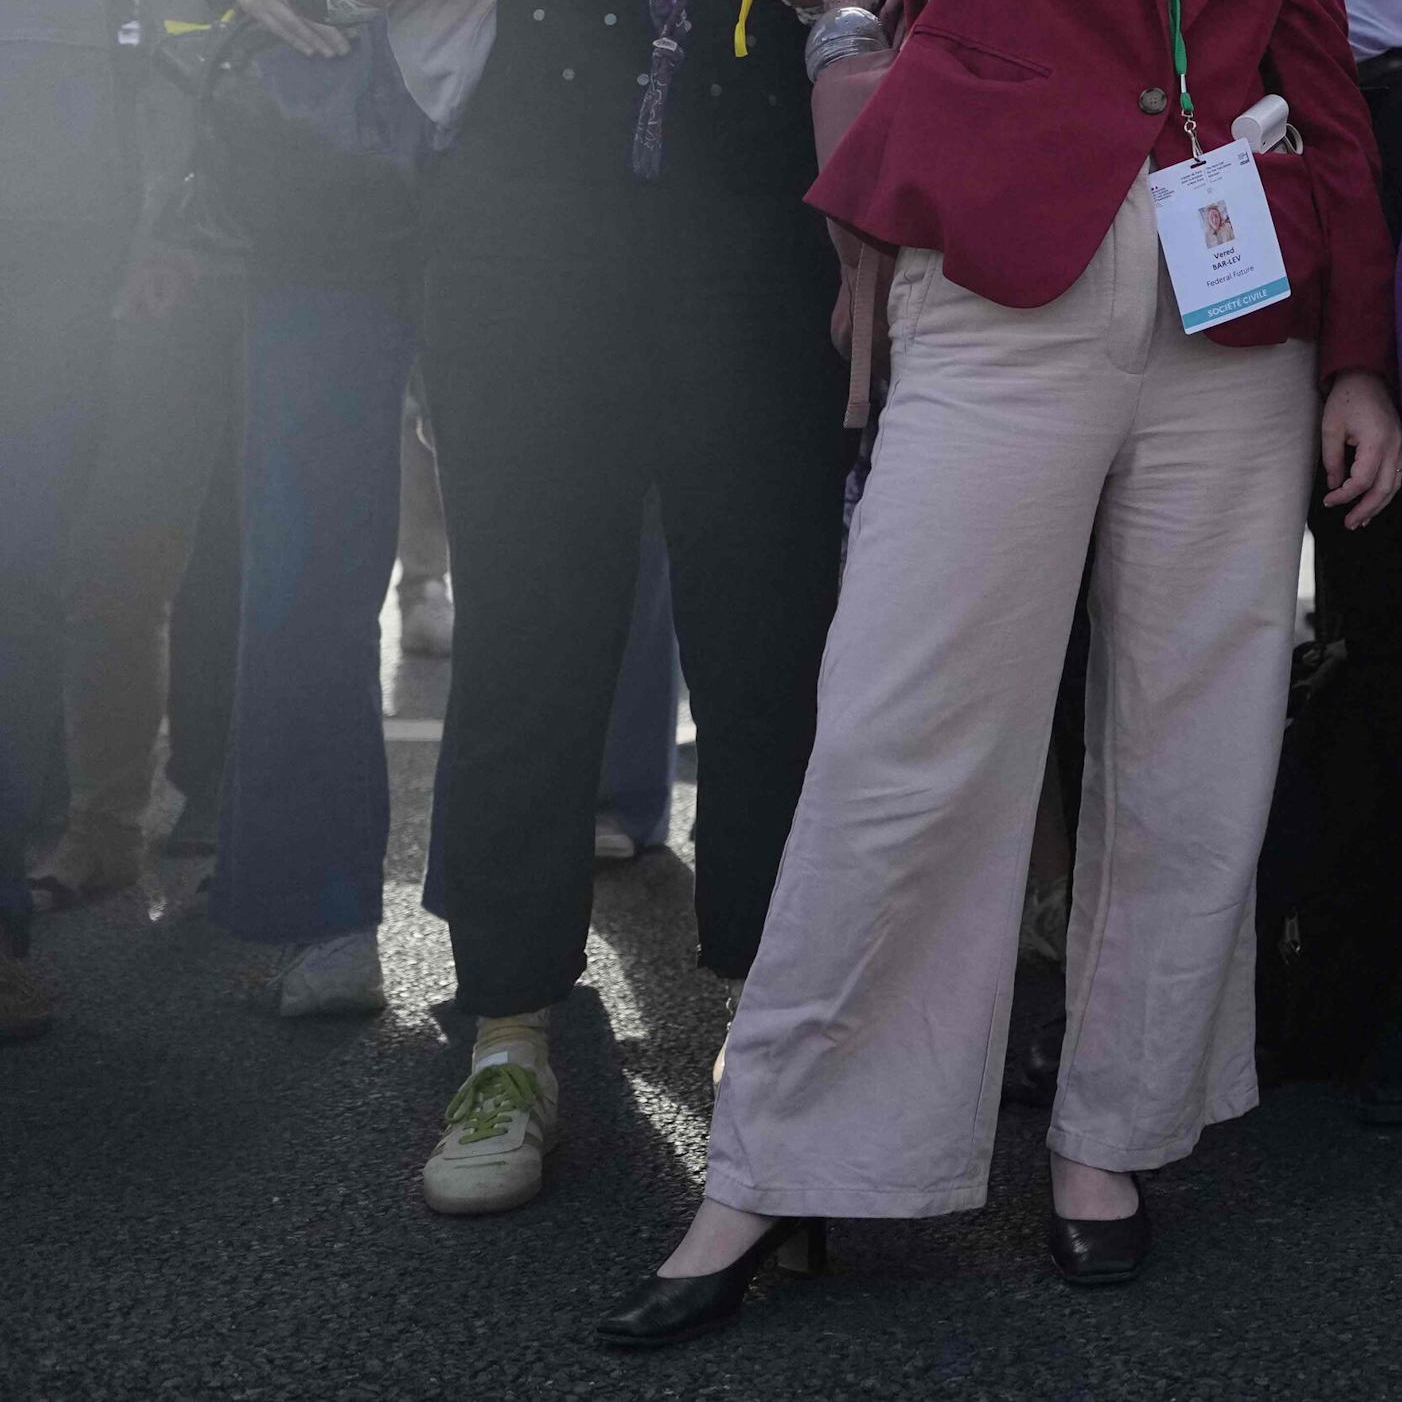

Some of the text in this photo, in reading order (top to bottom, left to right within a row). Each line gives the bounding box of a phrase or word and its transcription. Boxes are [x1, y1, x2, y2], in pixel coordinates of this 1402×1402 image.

[1213, 247, 1235, 259] Vered
[1212, 254, 1241, 271] BAR-LEV
[1206, 265, 1255, 287] Federal Future
[1242, 288, 1268, 304] CIVILE
